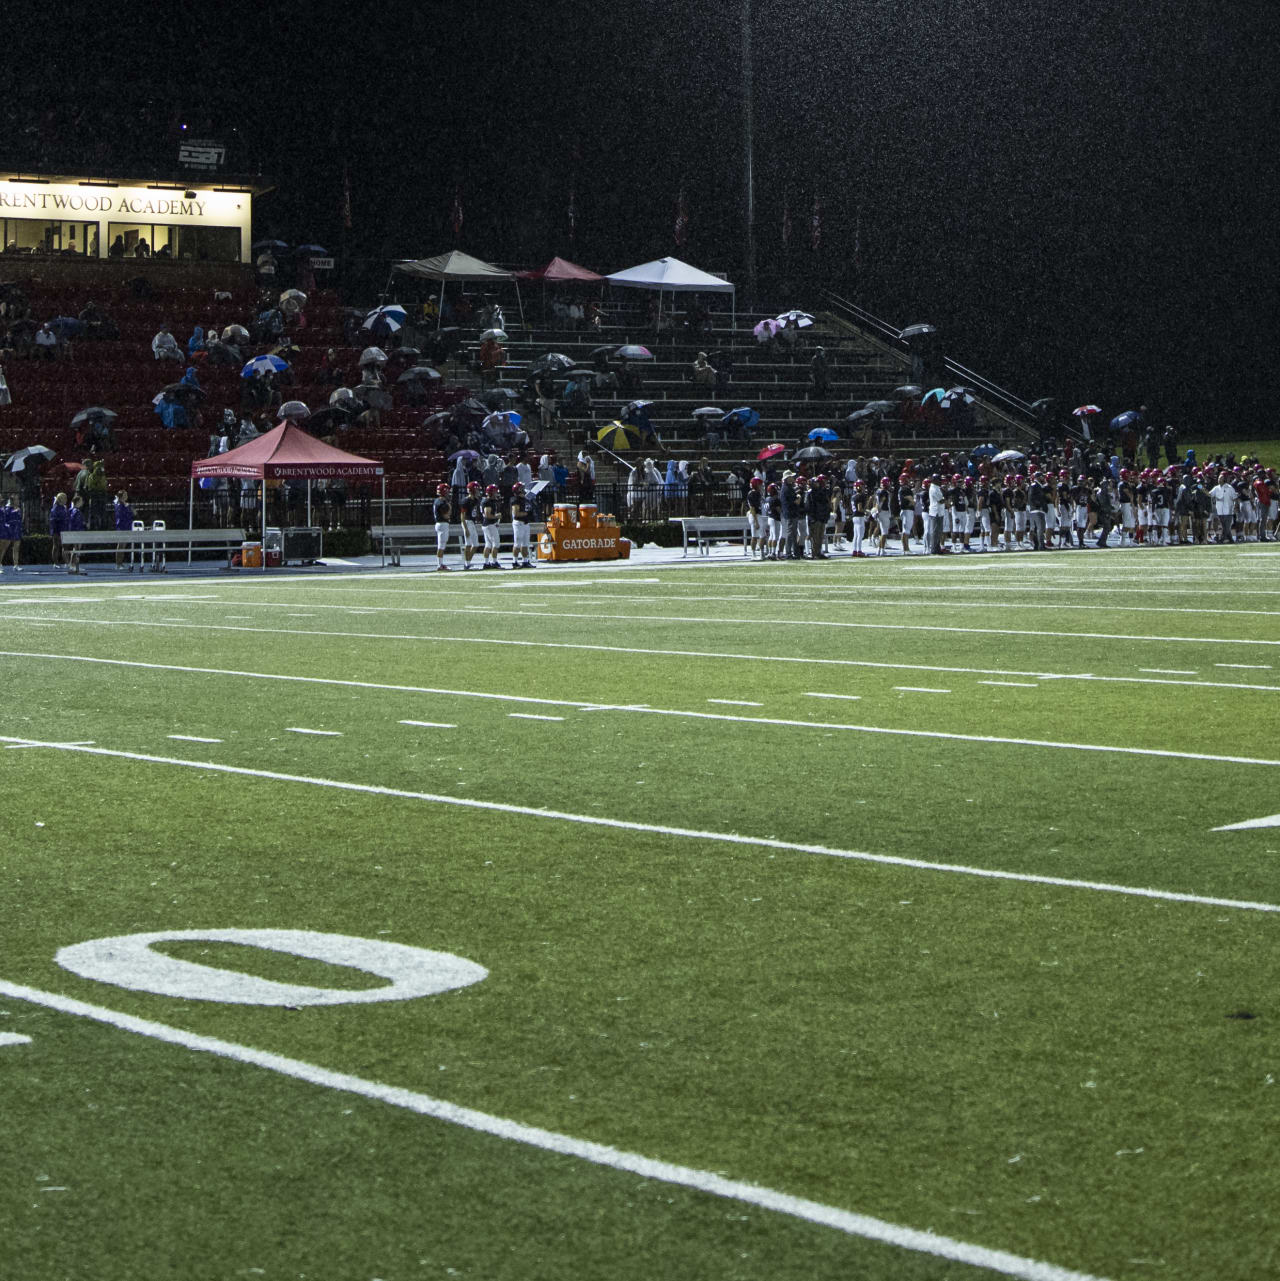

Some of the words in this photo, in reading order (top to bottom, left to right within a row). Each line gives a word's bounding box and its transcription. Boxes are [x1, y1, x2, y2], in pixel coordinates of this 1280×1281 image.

[118, 197, 207, 216] ACADEMY
[282, 468, 335, 476] BRENTWOOD
[337, 467, 375, 475] ACADEMY
[562, 538, 616, 550] GATORADE
